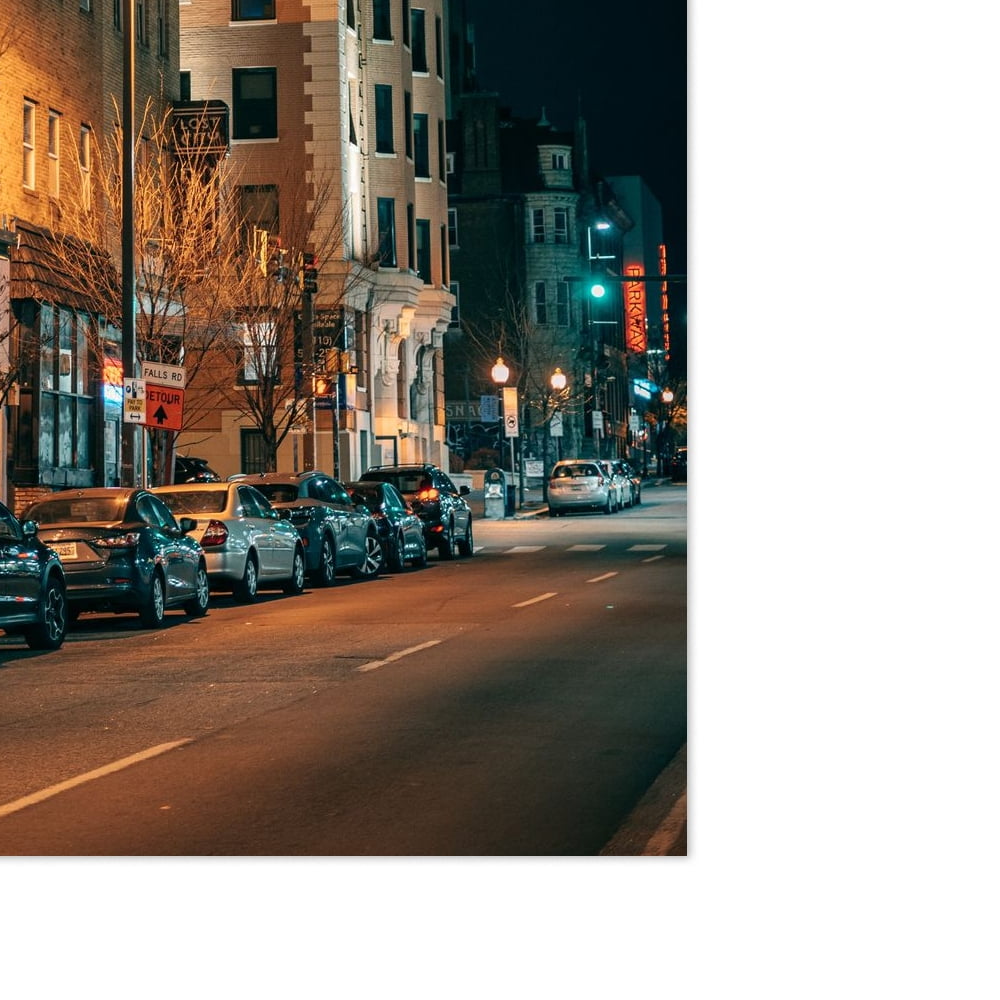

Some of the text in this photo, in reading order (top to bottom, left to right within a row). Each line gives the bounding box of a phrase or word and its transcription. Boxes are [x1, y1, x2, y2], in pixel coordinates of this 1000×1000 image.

[628, 268, 643, 352] PARKWAY
[144, 368, 183, 382] FALLS RD
